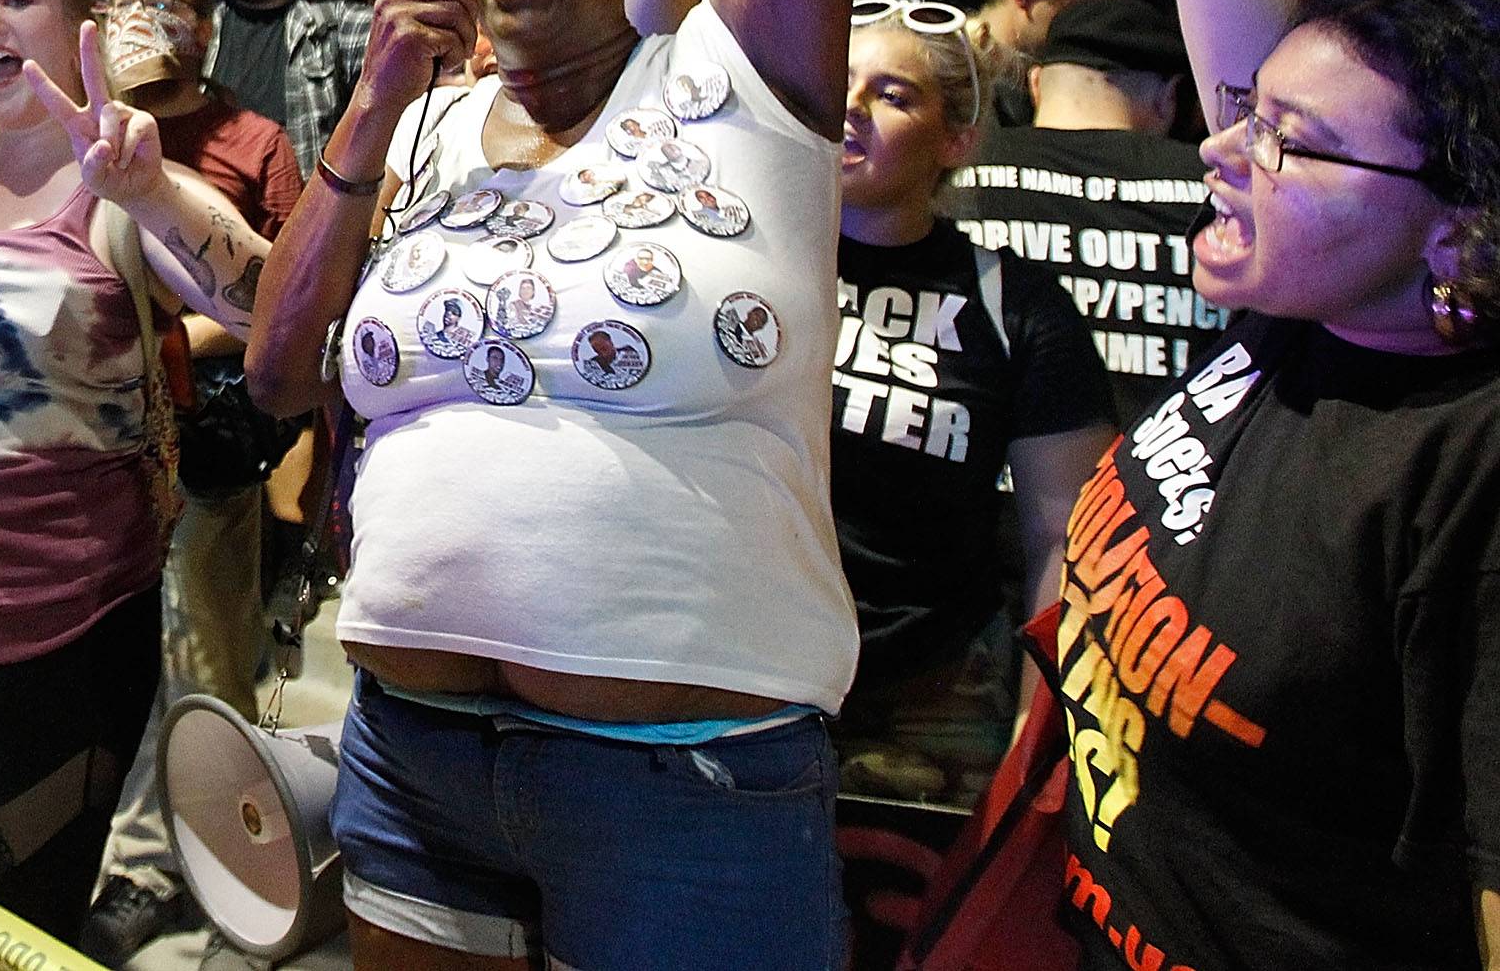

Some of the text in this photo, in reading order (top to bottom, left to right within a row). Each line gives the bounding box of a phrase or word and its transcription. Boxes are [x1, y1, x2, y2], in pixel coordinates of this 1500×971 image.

[976, 165, 1018, 188] THE
[1020, 167, 1083, 198] NAME
[1085, 176, 1116, 201] OF
[1117, 180, 1211, 204] HUMAN
[1079, 228, 1161, 271] OUT
[832, 370, 970, 463] TER
